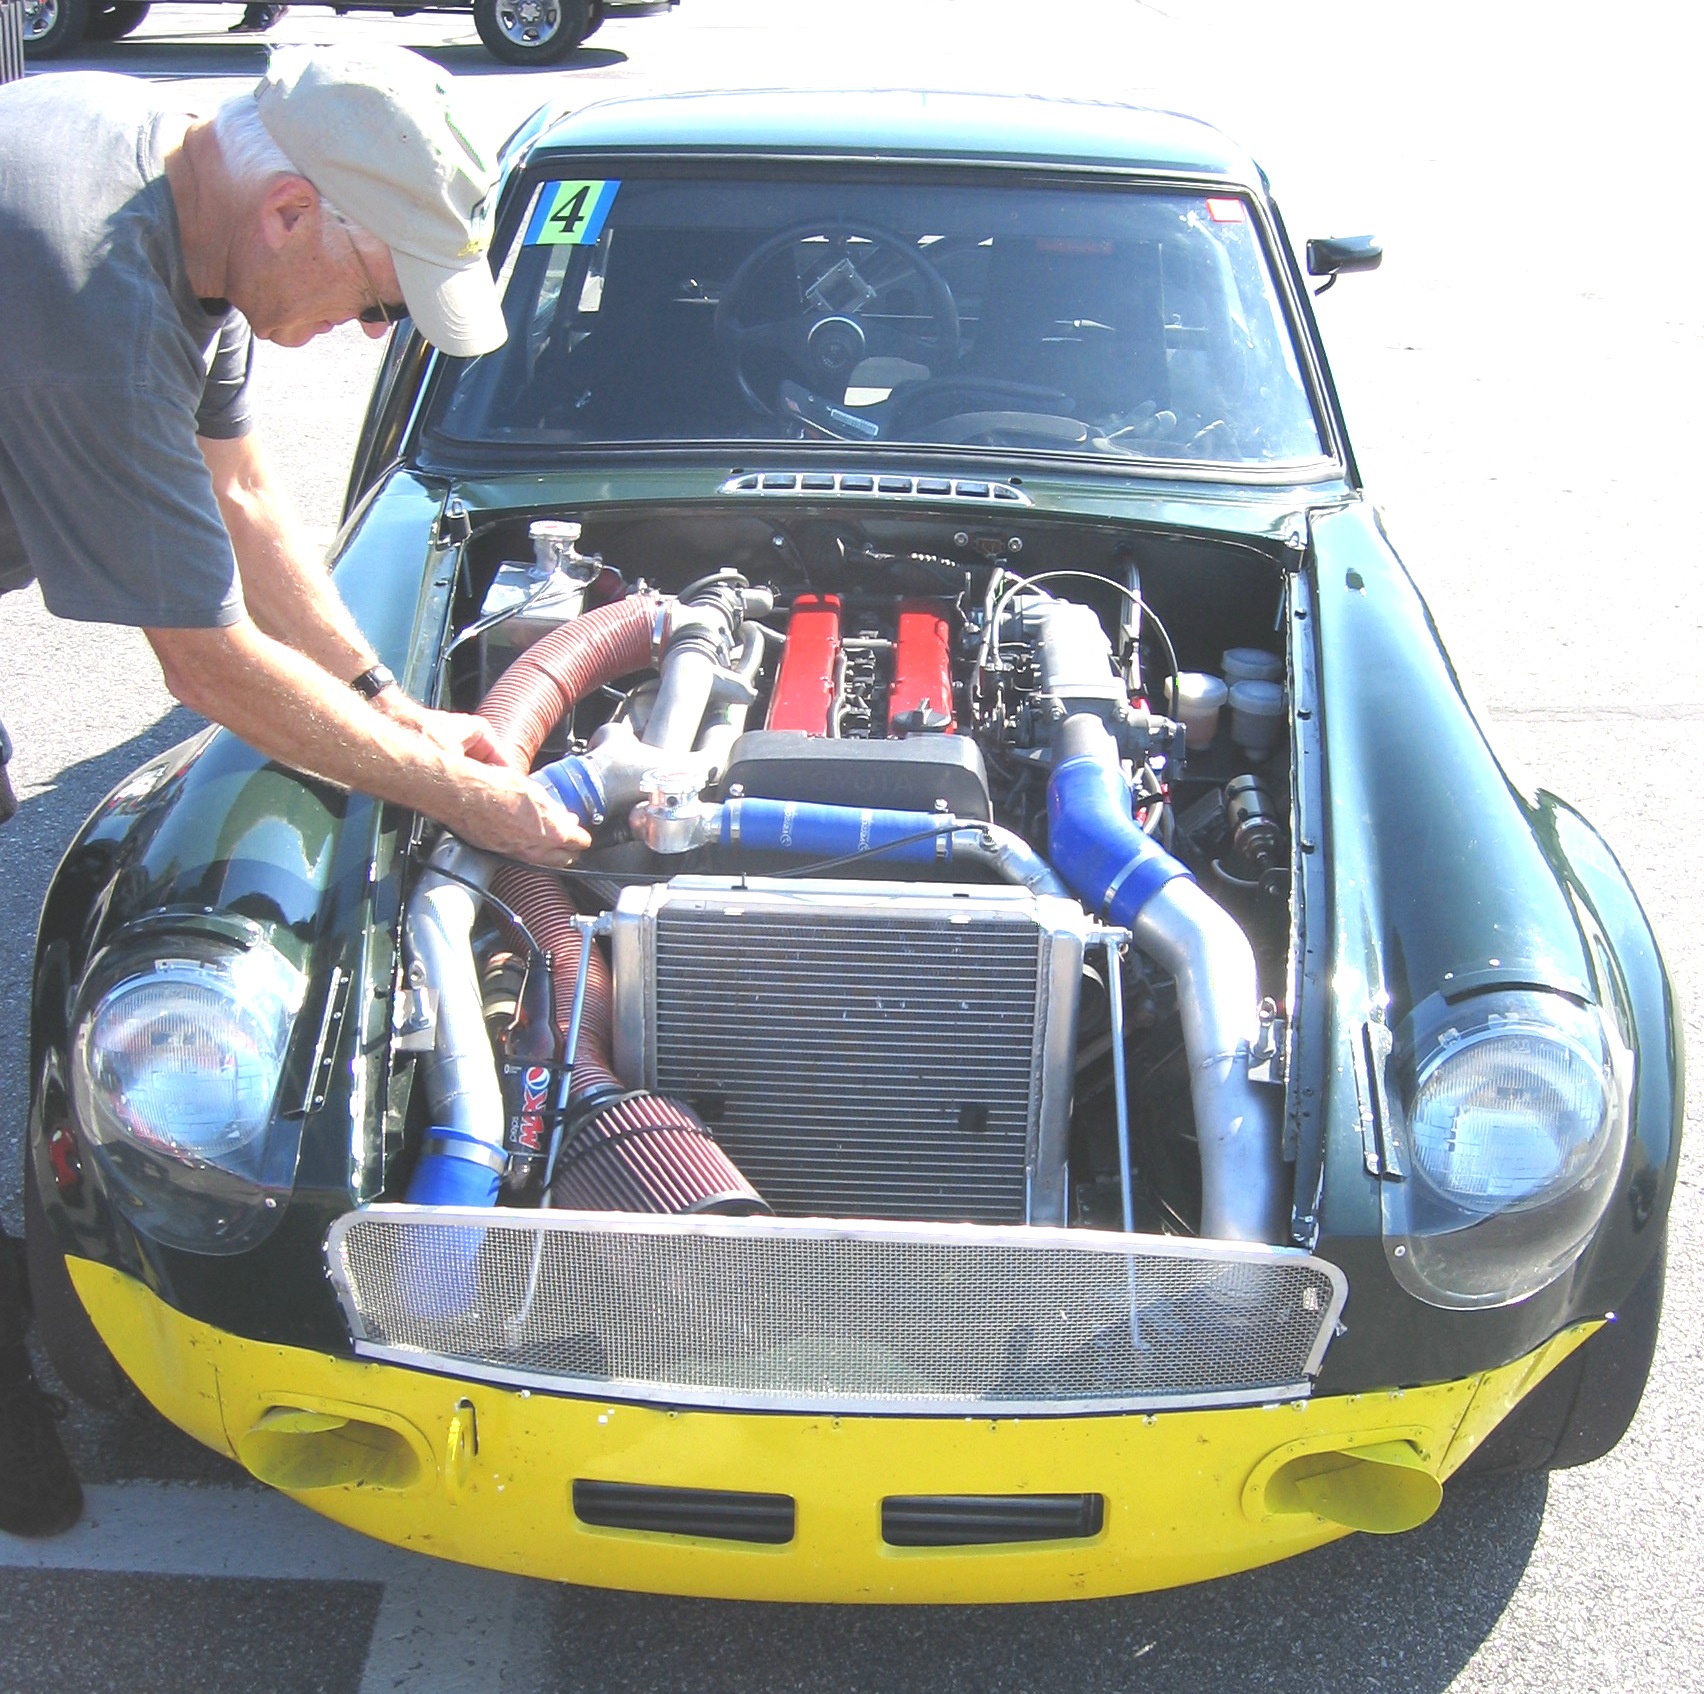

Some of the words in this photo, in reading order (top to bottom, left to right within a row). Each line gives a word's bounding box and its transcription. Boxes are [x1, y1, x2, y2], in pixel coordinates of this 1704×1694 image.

[549, 185, 591, 232] 4
[509, 1115, 519, 1142] peps
[519, 1086, 547, 1150] MAX
